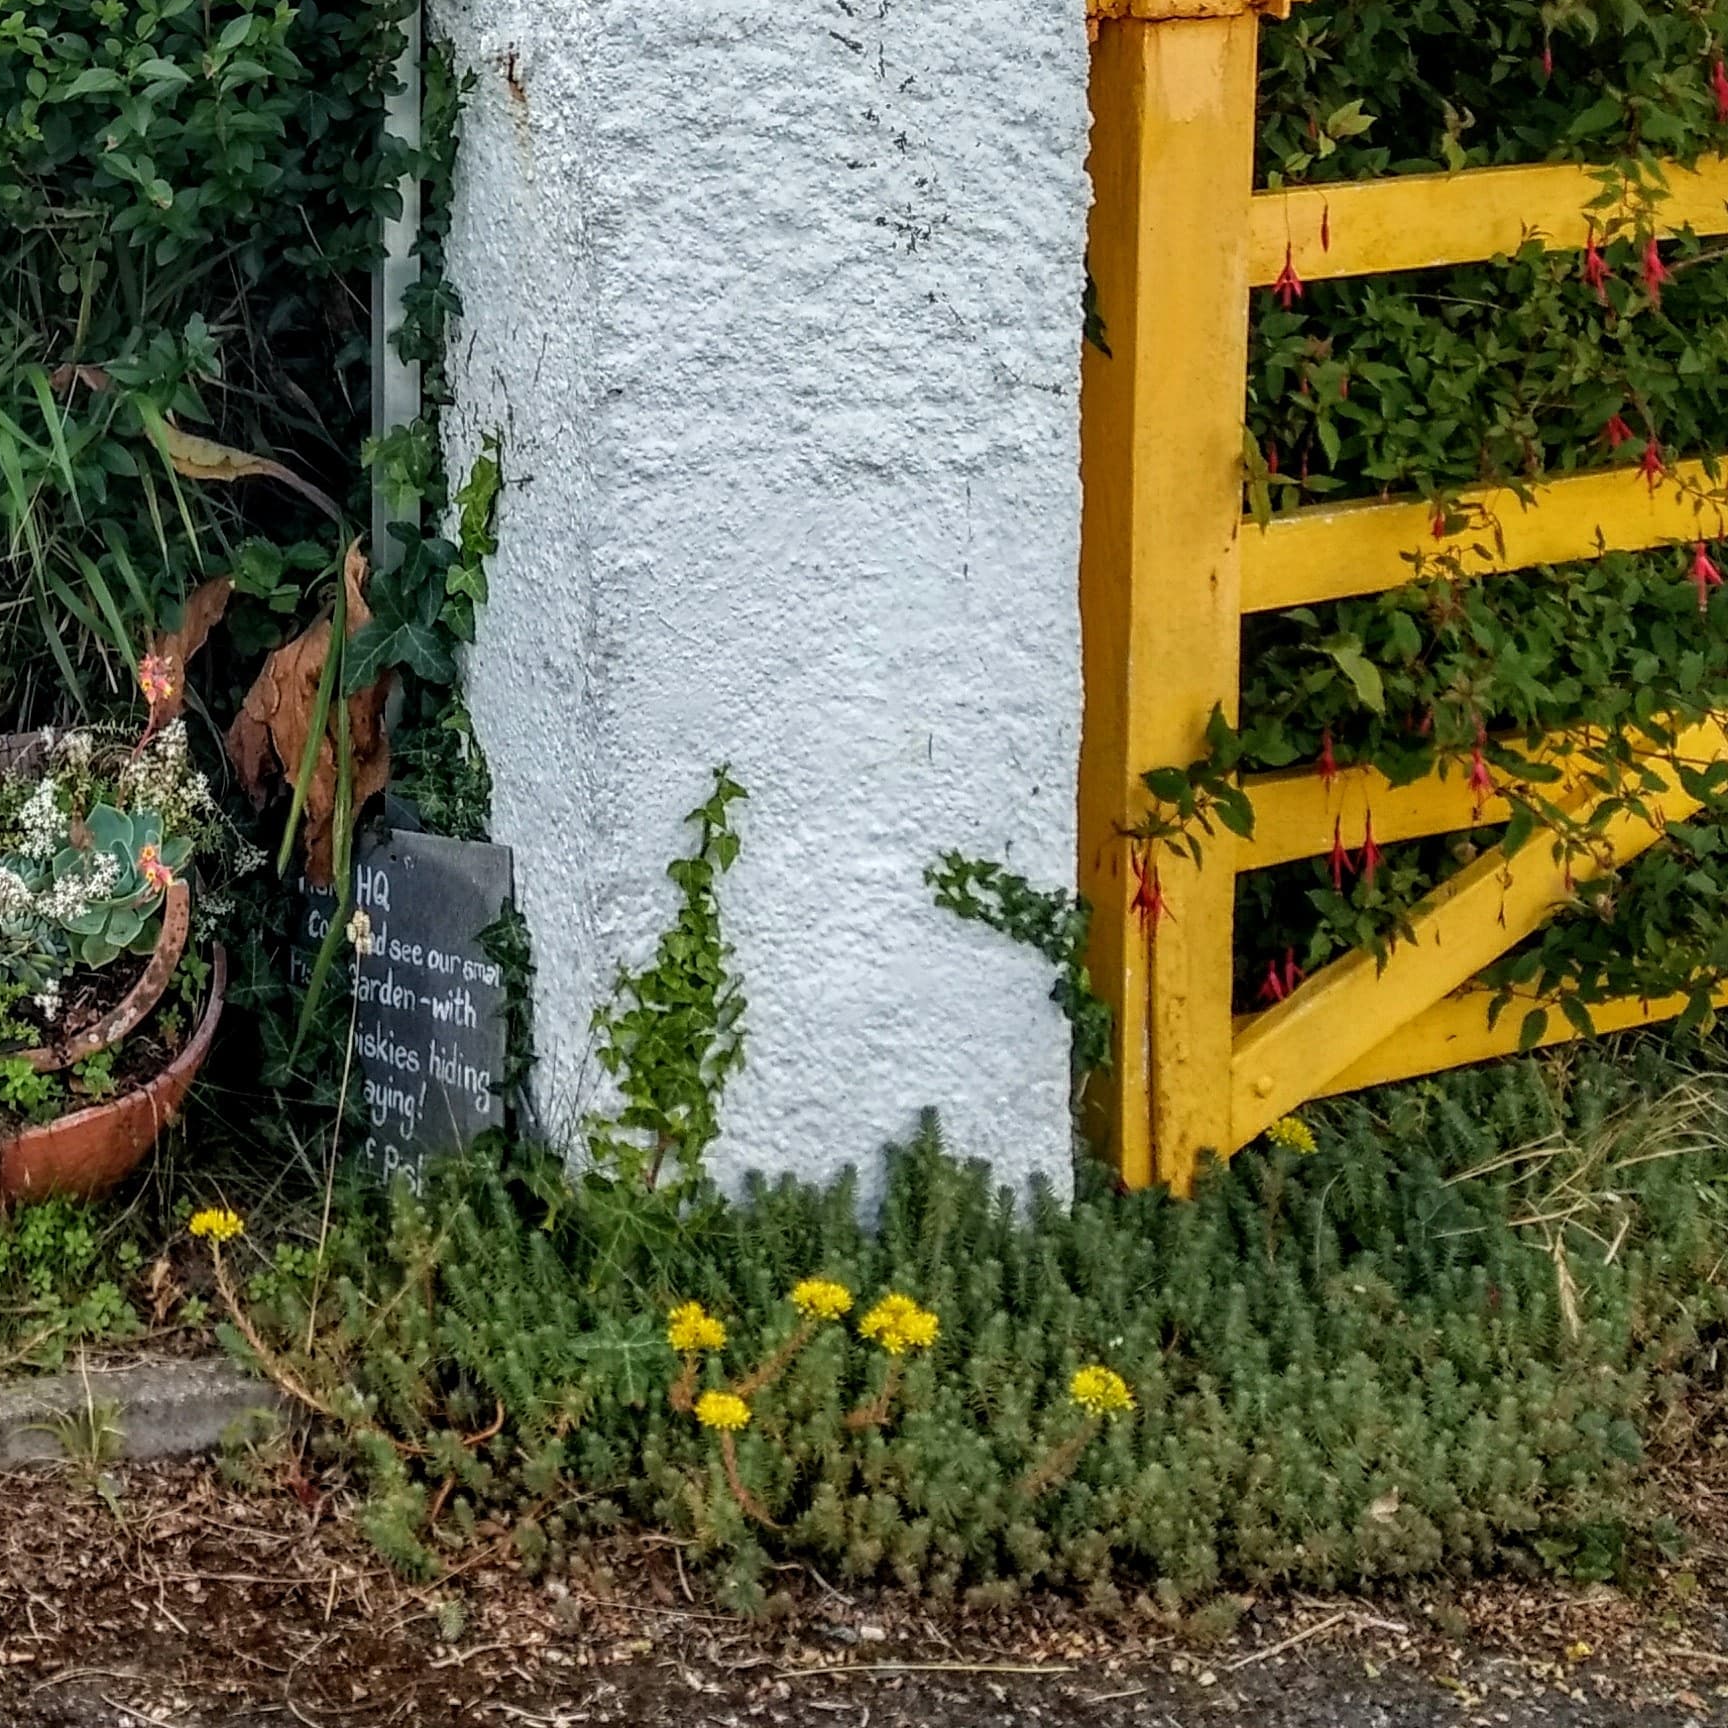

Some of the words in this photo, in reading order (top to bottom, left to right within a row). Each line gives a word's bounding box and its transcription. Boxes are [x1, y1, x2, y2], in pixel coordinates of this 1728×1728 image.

[356, 863, 391, 913] HQ
[389, 938, 423, 966] see
[428, 949, 462, 974] our
[429, 1039, 491, 1113] hiding
